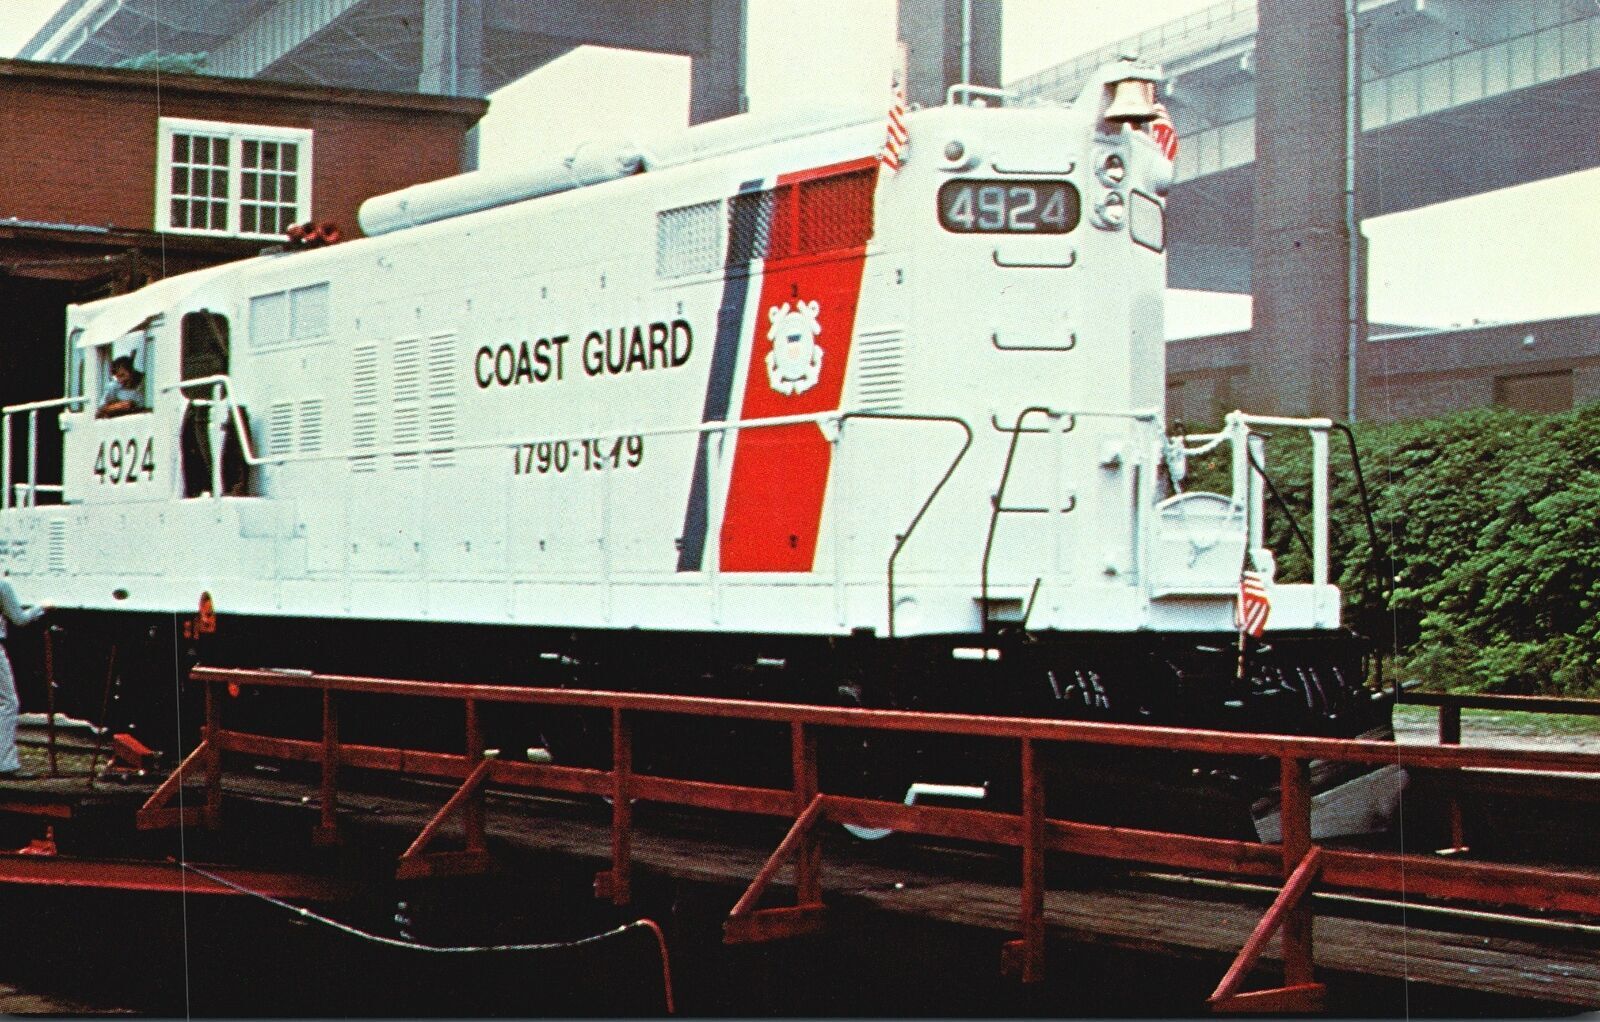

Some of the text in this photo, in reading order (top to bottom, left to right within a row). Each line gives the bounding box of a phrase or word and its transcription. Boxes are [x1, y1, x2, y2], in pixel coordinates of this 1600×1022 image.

[949, 186, 1065, 231] 4924
[474, 319, 694, 389] COAST GUARD
[93, 436, 155, 485] 4924
